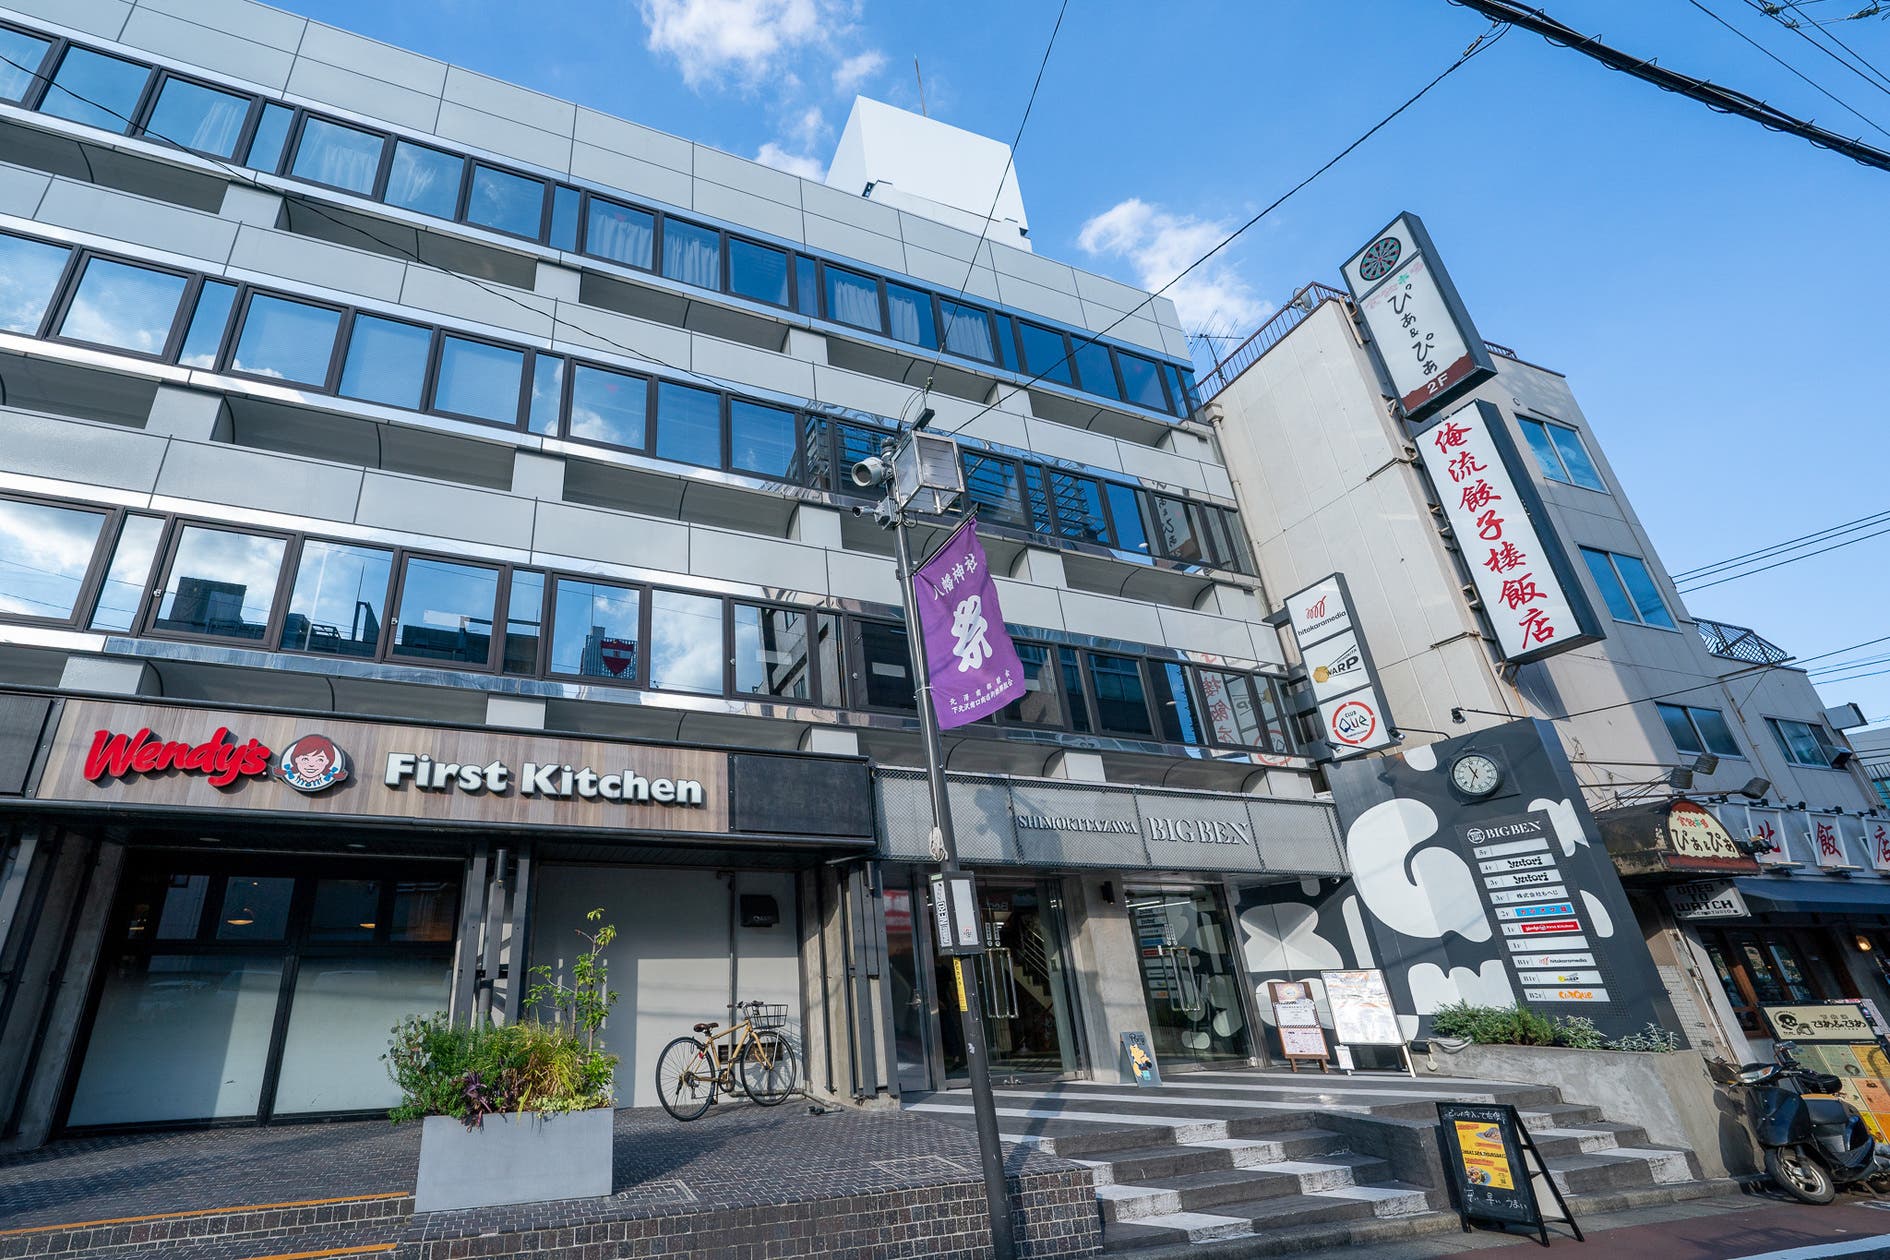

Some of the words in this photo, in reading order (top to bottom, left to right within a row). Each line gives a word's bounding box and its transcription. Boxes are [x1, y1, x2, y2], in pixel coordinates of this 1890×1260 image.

[1426, 374, 1448, 397] 2F
[1434, 421, 1554, 649] 俺流餃子楼飯店
[933, 553, 978, 600] 八幡神社
[951, 594, 993, 673] 祭
[1297, 610, 1347, 637] hitokaramedia
[1345, 710, 1357, 719] CLUB
[83, 726, 272, 788] Wendy's
[384, 750, 509, 796] First
[520, 760, 704, 808] Kitchen
[1148, 815, 1196, 844] BIG
[1198, 819, 1252, 846] BEN
[1485, 825, 1512, 839] BIG
[1513, 820, 1542, 836] BEN
[1675, 900, 1734, 912] WATCH
